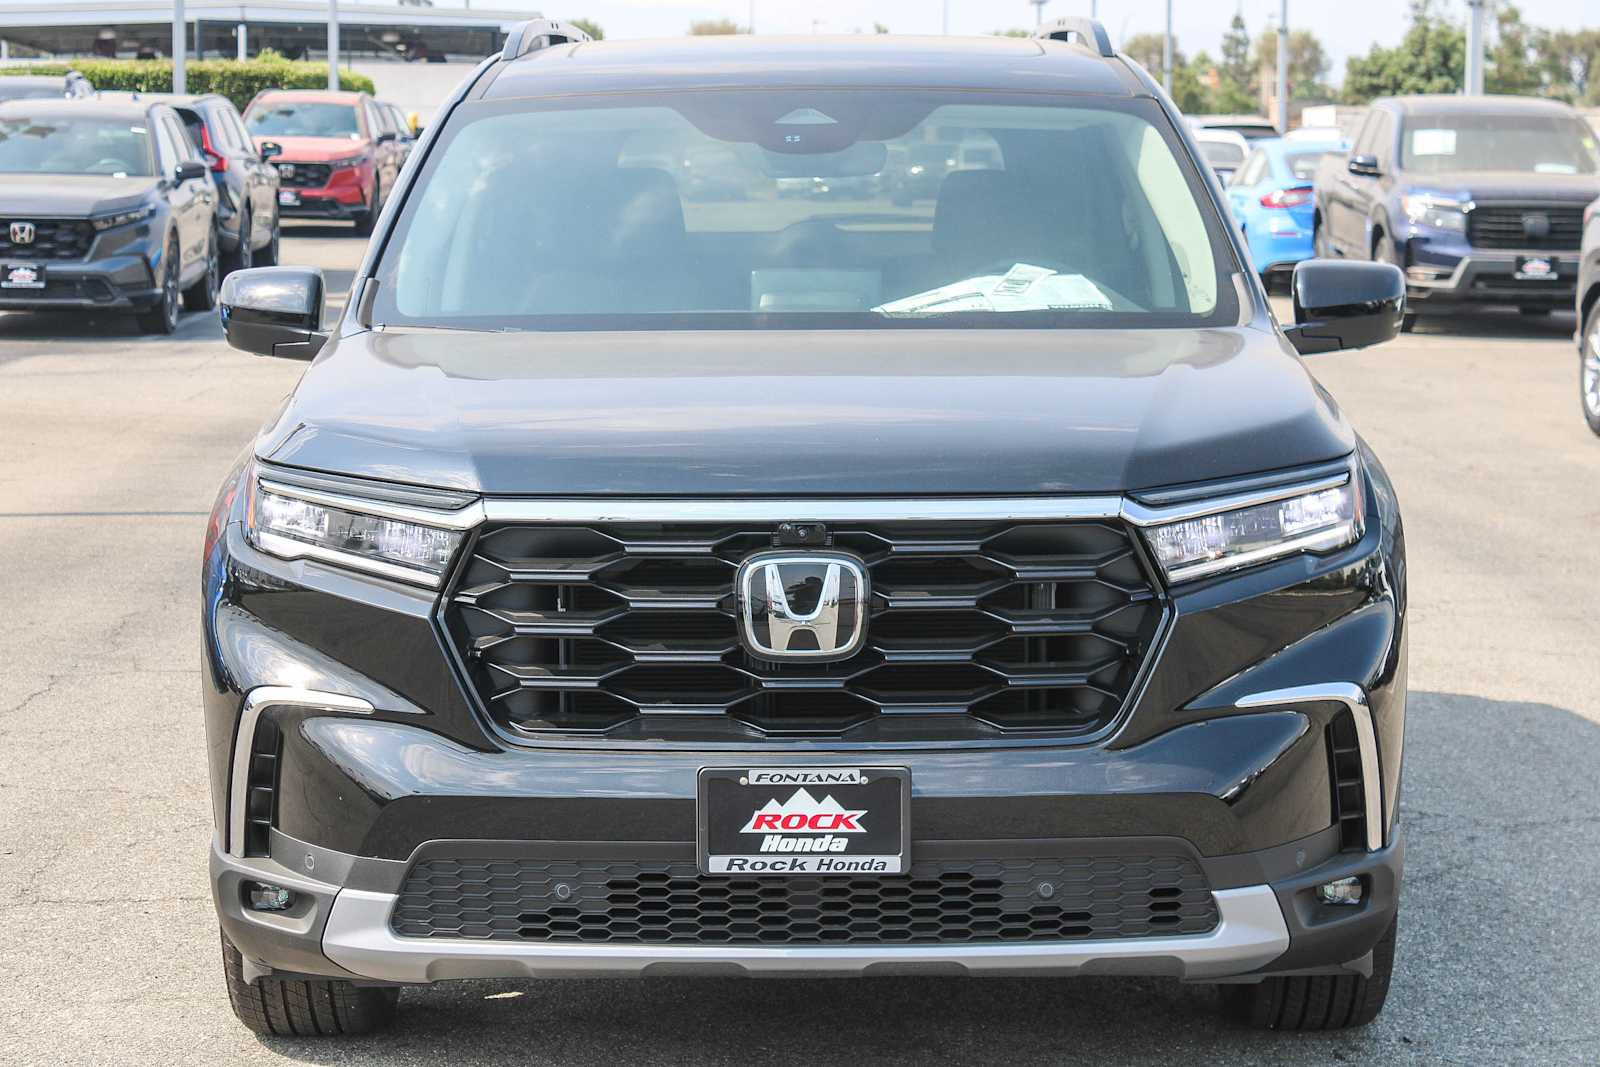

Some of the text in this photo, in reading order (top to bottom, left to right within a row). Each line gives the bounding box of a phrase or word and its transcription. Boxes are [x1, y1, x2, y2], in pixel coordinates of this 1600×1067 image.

[755, 773, 857, 783] FONTANA
[752, 814, 860, 830] ROCK
[759, 834, 849, 852] Honda
[726, 858, 888, 871] Rock Honda
